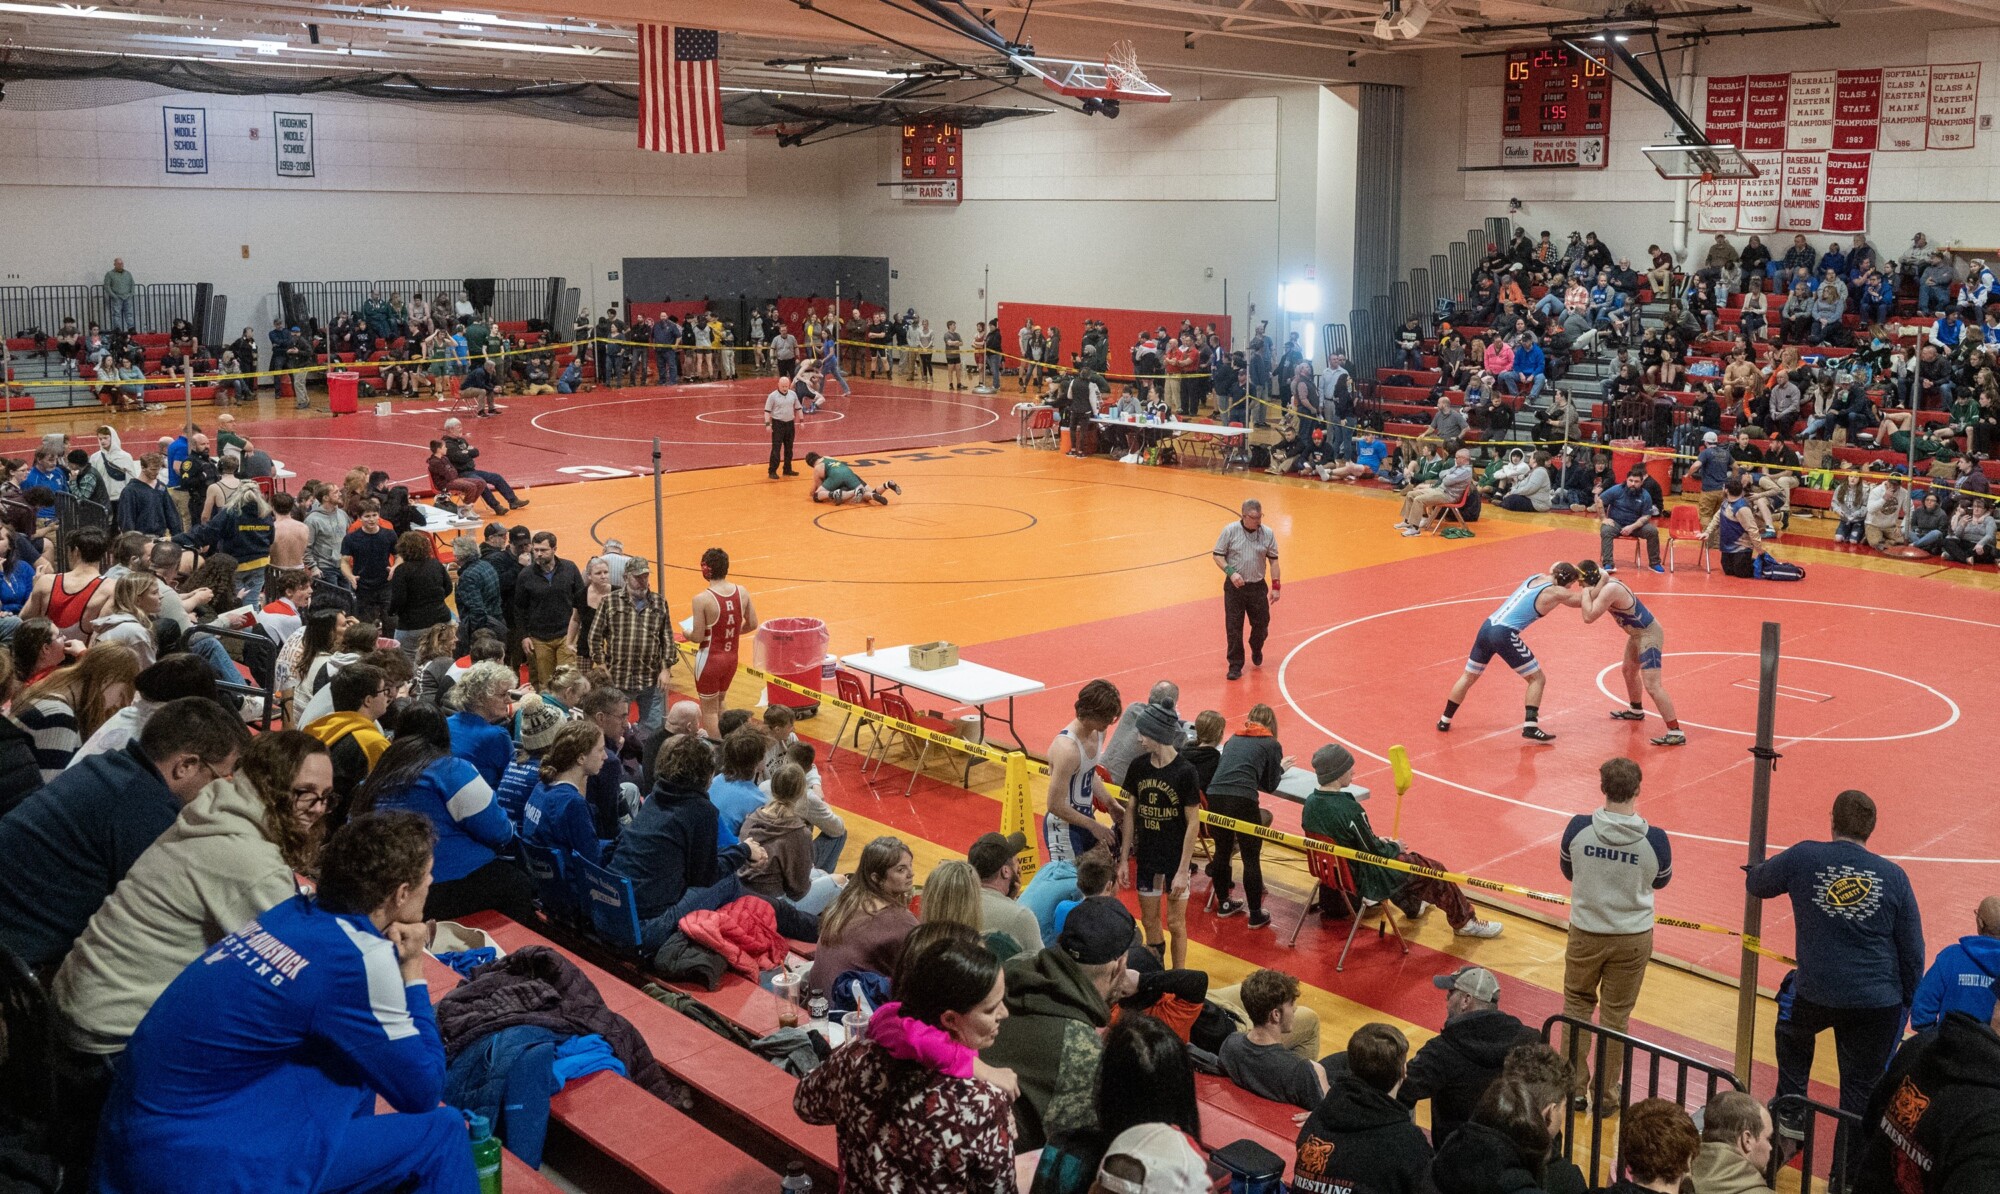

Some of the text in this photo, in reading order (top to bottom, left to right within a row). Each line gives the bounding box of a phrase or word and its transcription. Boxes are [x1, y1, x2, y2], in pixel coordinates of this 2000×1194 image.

[1510, 62, 1529, 80] 05
[1885, 70, 1928, 78] SOFTBALL
[1837, 76, 1881, 84] SOFTBALL
[1933, 72, 1976, 80] SOFTBALL
[1571, 74, 1579, 88] 3
[1750, 80, 1788, 88] BASEBALL
[1791, 77, 1835, 85] BASEBALL
[1887, 81, 1915, 89] CLASS
[1708, 82, 1744, 90] BASEBALL
[1935, 83, 1972, 92] CLASS A
[1885, 92, 1926, 100] EASTERN
[1933, 95, 1973, 103] EASTERN
[1793, 97, 1830, 105] EASTERN
[1544, 105, 1567, 119] 195
[1888, 104, 1920, 112] MAINE
[1937, 107, 1966, 115] MAINE
[174, 114, 195, 124] BUKER
[1789, 119, 1832, 127] CHAMPIONS
[1834, 119, 1878, 127] CHAMPIONS
[1881, 116, 1926, 124] CHAMPIONS
[1930, 118, 1974, 126] CHAMPIONS
[279, 118, 308, 129] HODGKINS
[1706, 121, 1743, 129] CHAMPIONS
[1746, 120, 1786, 129] CHAMPIONS
[174, 127, 196, 138] MIDDLE
[284, 131, 304, 142] MIDDLE
[174, 140, 198, 151] SCHOOL
[1556, 140, 1563, 148] of
[1565, 140, 1577, 148] the
[283, 144, 306, 154] SCHOOL
[1505, 146, 1529, 156] Charlie's
[1533, 149, 1577, 162] RAMS
[1828, 161, 1869, 169] SOFTBALL
[1741, 179, 1780, 187] EASTERN
[1787, 177, 1819, 186] EASTERN
[920, 187, 943, 197] RAMS
[1791, 188, 1813, 197] MAINE
[1826, 195, 1866, 203] CHAMPIONS
[1784, 200, 1820, 208] CHAMPIONS
[724, 600, 735, 652] RAMS
[1149, 792, 1158, 804] OF
[1207, 813, 1236, 828] CAUTION
[1145, 819, 1160, 831] USA
[1584, 845, 1639, 865] CRUTE
[1880, 1116, 1932, 1171] WRESTLING
